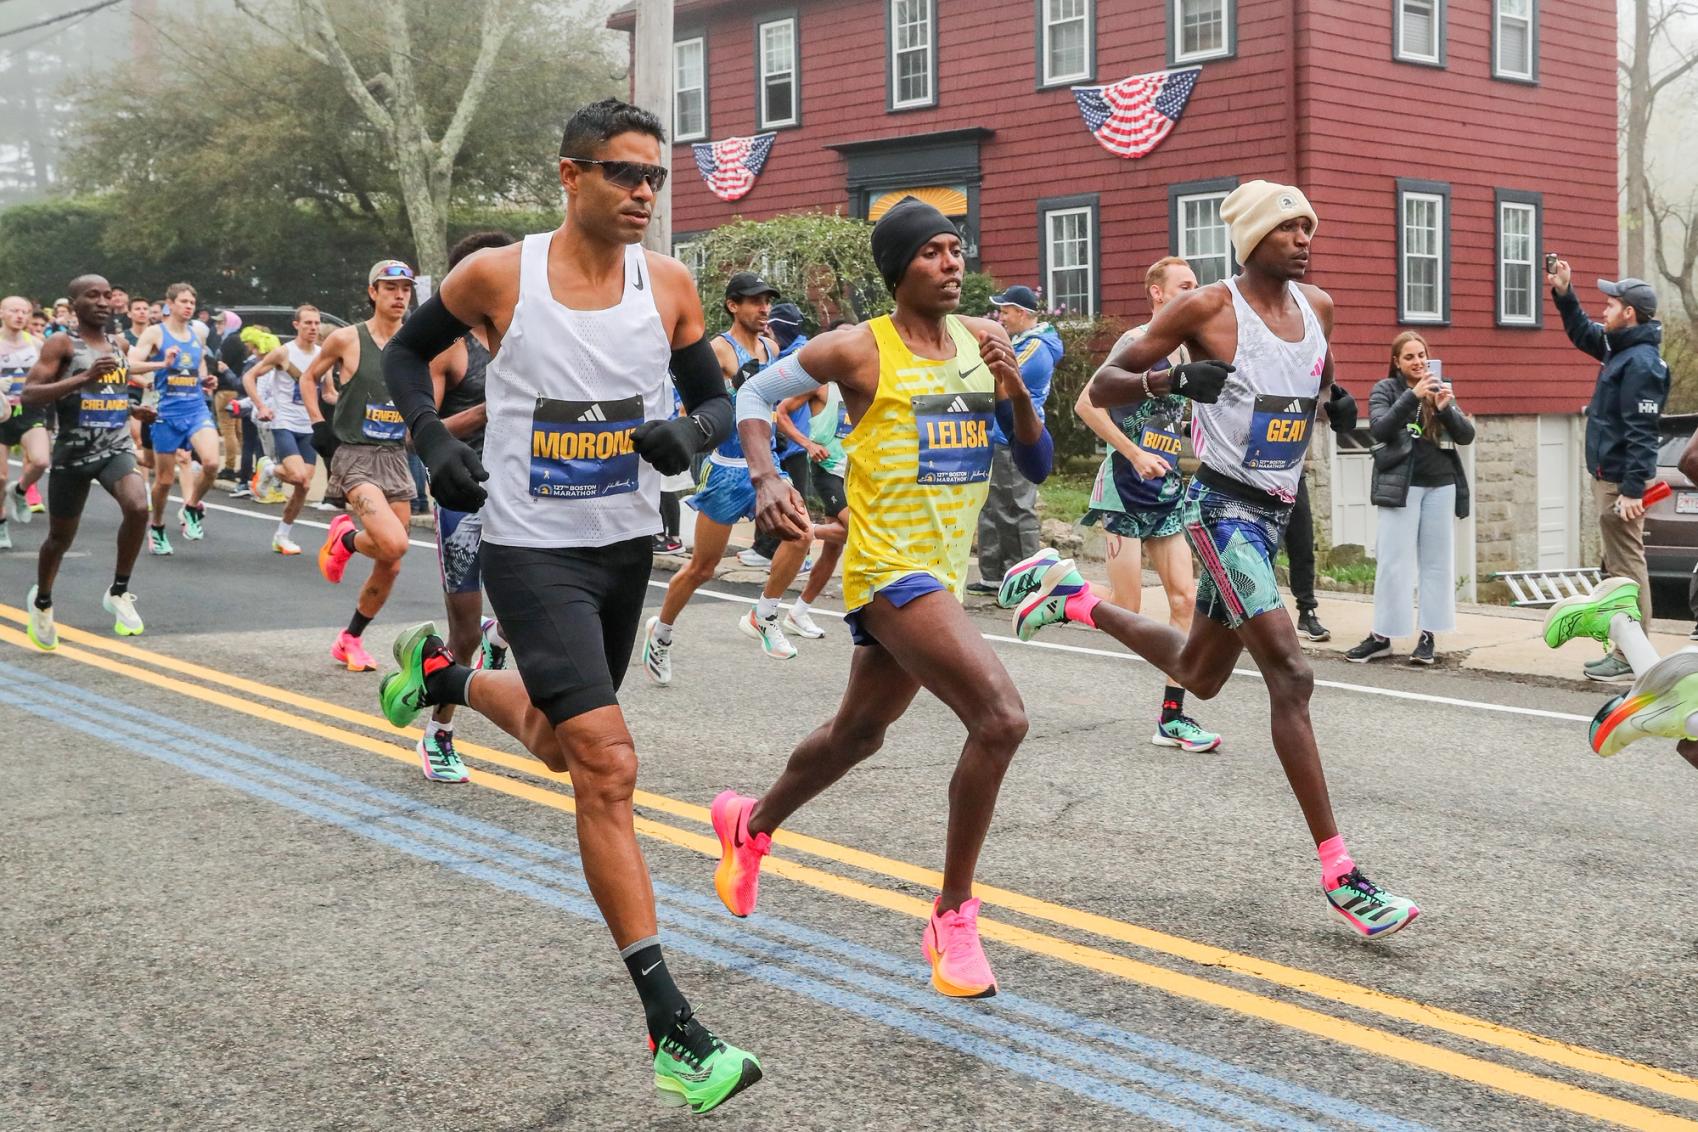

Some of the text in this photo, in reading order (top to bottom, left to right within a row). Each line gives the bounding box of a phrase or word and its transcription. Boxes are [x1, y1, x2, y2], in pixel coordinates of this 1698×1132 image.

[1638, 402, 1658, 414] HH
[926, 420, 988, 449] LELISA
[1266, 419, 1307, 442] GEAY
[1143, 431, 1182, 455] BUTLE
